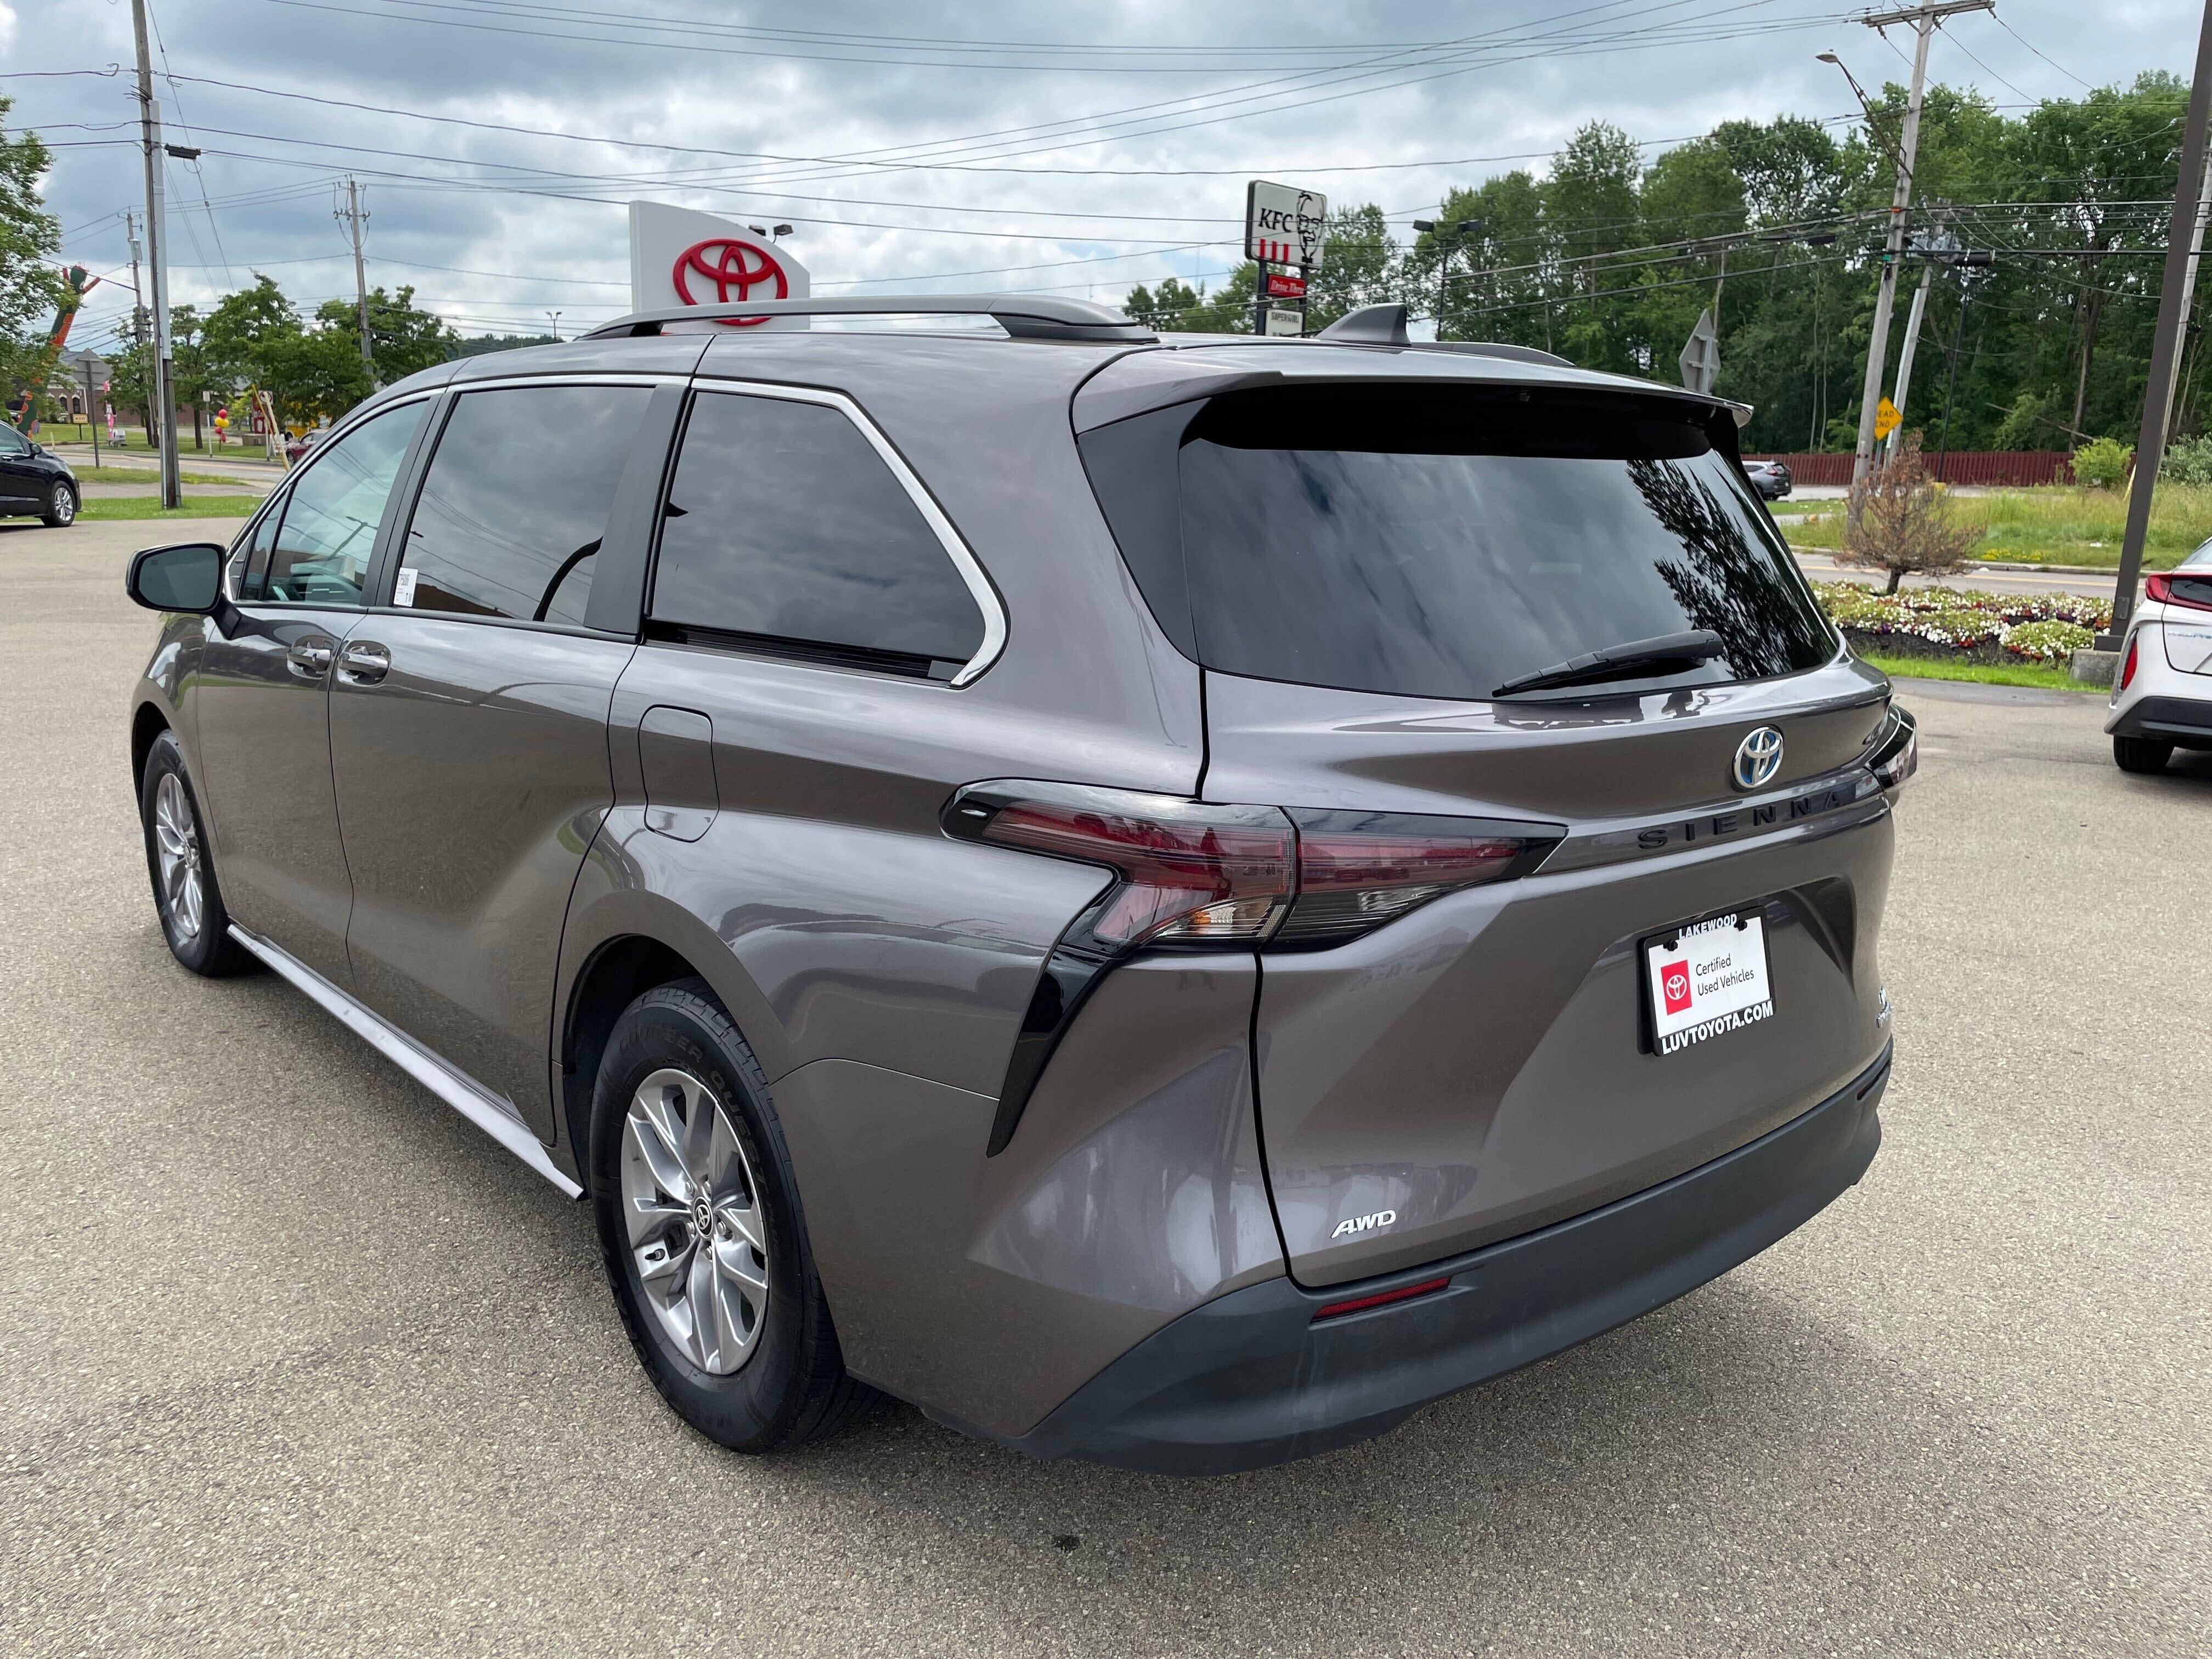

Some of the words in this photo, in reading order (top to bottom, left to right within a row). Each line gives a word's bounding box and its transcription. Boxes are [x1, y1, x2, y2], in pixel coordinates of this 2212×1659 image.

[1259, 207, 1294, 233] KFC
[1638, 791, 1841, 850] SIENNA
[1678, 913, 1737, 940] LAKEWOOD
[1696, 953, 1731, 976] Certified
[1697, 979, 1719, 996] Used
[1719, 969, 1754, 988] Vehicles
[1661, 1000, 1774, 1056] LUVTOYOTA.COM
[1330, 1210, 1397, 1239] AWD
